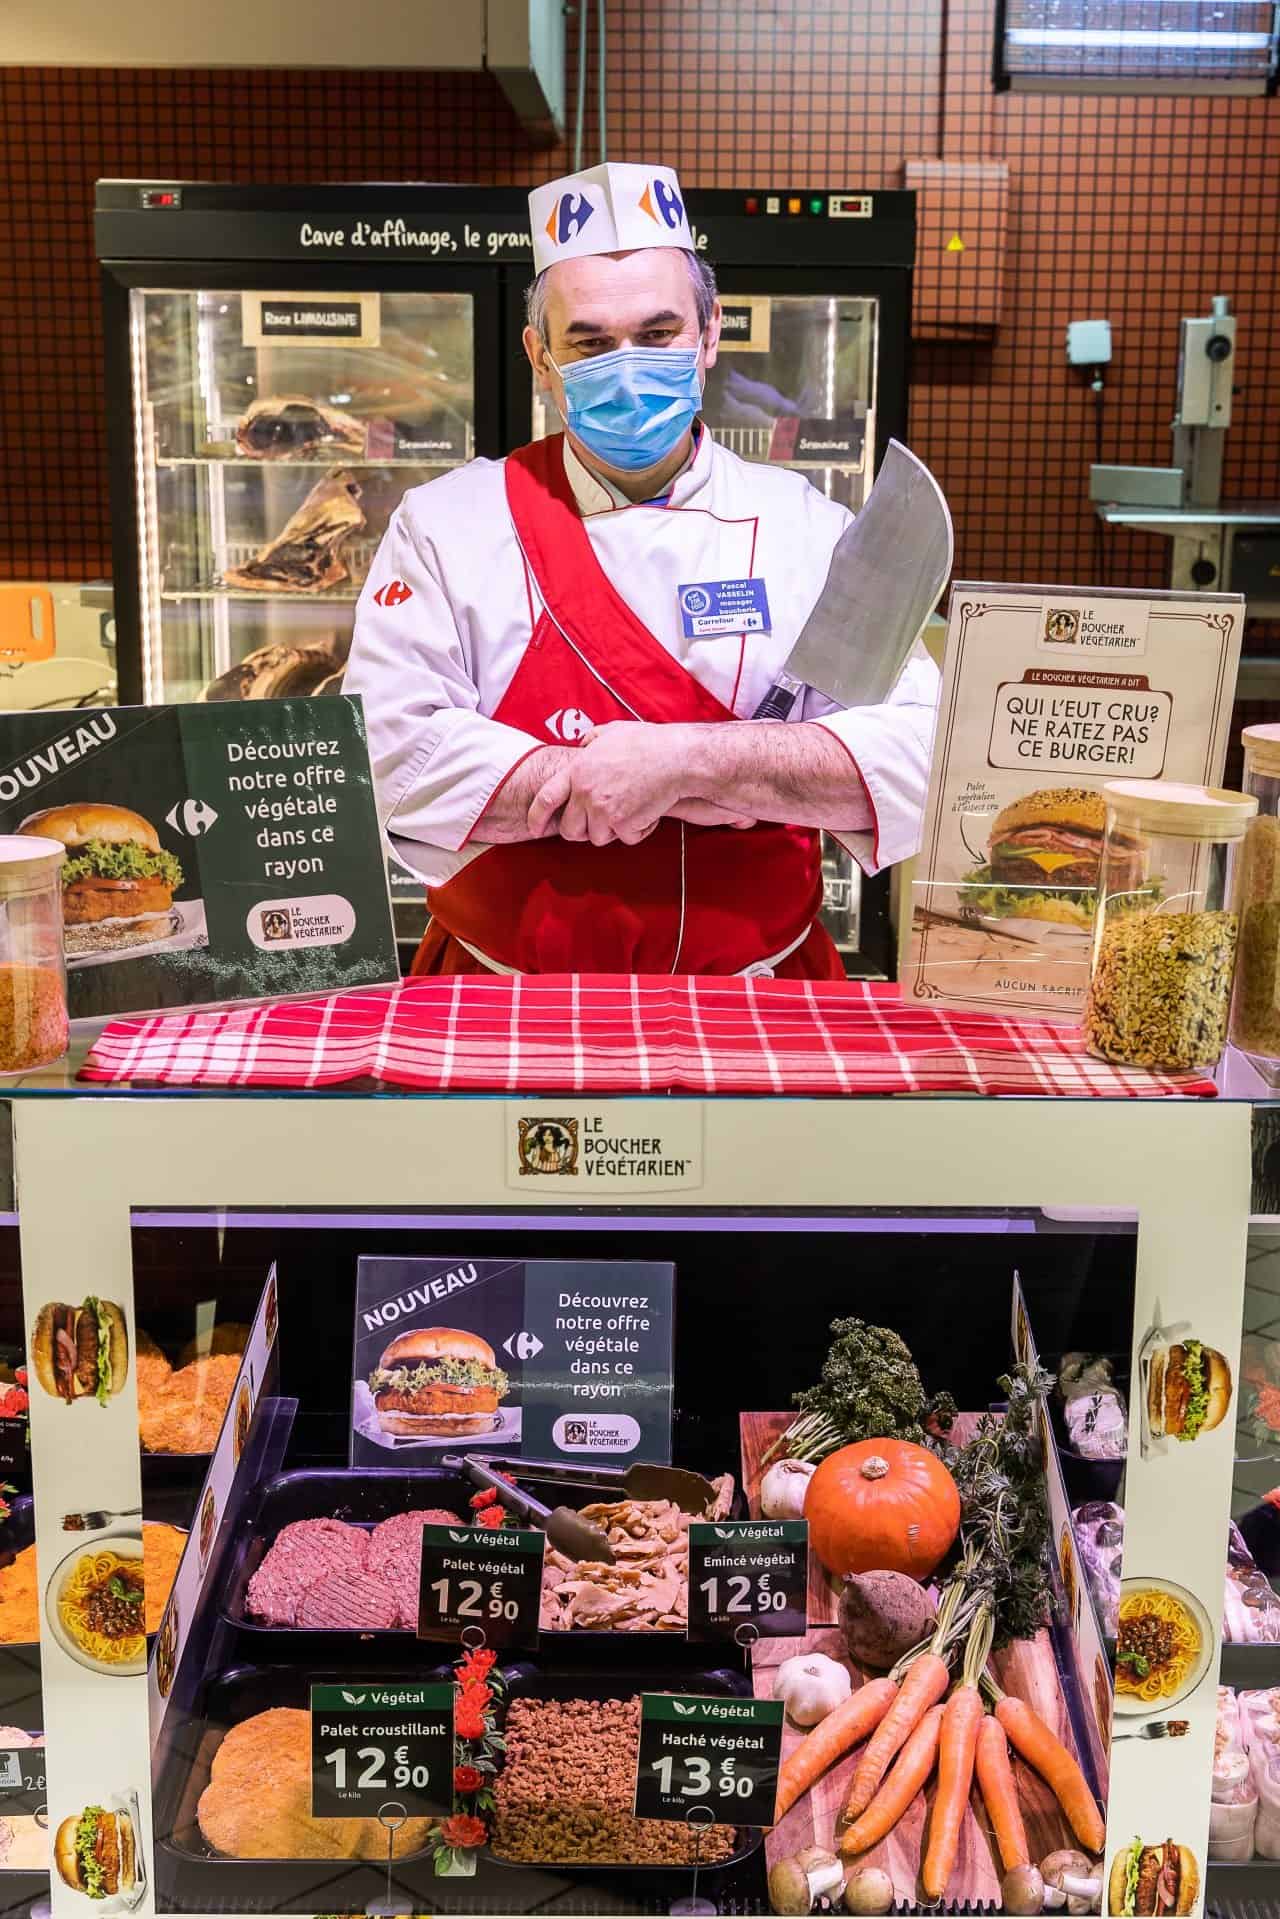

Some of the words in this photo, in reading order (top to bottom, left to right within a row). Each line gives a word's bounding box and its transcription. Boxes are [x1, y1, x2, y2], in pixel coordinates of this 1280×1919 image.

[300, 223, 345, 247] Cave
[351, 219, 457, 255] d'affinage,
[464, 224, 480, 247] le
[487, 231, 533, 255] gran
[691, 225, 708, 250] le
[293, 312, 358, 327] LIMOUSINE
[721, 315, 749, 329] SINE
[721, 581, 747, 590] Pascal
[716, 590, 754, 599] VASSELIN
[698, 617, 734, 626] Carrefour
[1083, 610, 1094, 620] LE
[1082, 623, 1125, 634] BOUCHER
[1032, 671, 1041, 681] LE
[1042, 673, 1075, 683] BOUCHER
[1128, 678, 1141, 687] DIT
[1006, 697, 1044, 716] QUI
[1051, 699, 1102, 719] L'EUT
[1107, 703, 1159, 723] CRU?
[1010, 718, 1039, 737] NE
[1045, 720, 1106, 741] RATEZ
[1112, 724, 1149, 744] PAS
[0, 712, 117, 800] OUVEAU
[227, 740, 340, 762] Découvrez
[1017, 740, 1043, 758] CE
[1050, 742, 1135, 764] BURGER!
[229, 771, 287, 791] notre
[293, 765, 345, 786] offre
[244, 794, 337, 821] végétale
[256, 828, 306, 848] dans
[312, 828, 335, 843] ce
[264, 857, 323, 879] rayon
[291, 907, 302, 916] LE
[292, 915, 330, 927] BOUCHER
[994, 980, 1036, 992] AUCUN
[1042, 984, 1083, 997] SACRIF
[584, 1117, 603, 1133] LE
[584, 1138, 662, 1155] BOUCHER
[362, 1263, 478, 1331] NOUVEAU
[559, 1291, 649, 1308] Découvrez
[556, 1316, 602, 1330] notre
[607, 1315, 650, 1330] offre
[565, 1336, 640, 1355] végétale
[570, 1358, 610, 1374] dans
[614, 1362, 634, 1375] ce
[573, 1384, 620, 1399] rayon
[589, 1429, 620, 1438] BOUCHER
[473, 1533, 520, 1546] Végétal
[739, 1526, 784, 1539] Végétal
[443, 1558, 477, 1571] Palet
[478, 1561, 525, 1575] végétal
[703, 1555, 747, 1567] Emincé
[750, 1553, 796, 1567] végétal
[431, 1578, 483, 1617] 12
[700, 1576, 752, 1613] 12
[371, 1691, 425, 1705] Végétal
[701, 1704, 755, 1718] Végétal
[320, 1724, 359, 1737] Palet
[362, 1722, 447, 1737] croustillant
[662, 1733, 706, 1746] Haché
[710, 1735, 764, 1750] végétal
[324, 1747, 387, 1789] 12
[651, 1756, 711, 1796] 13
